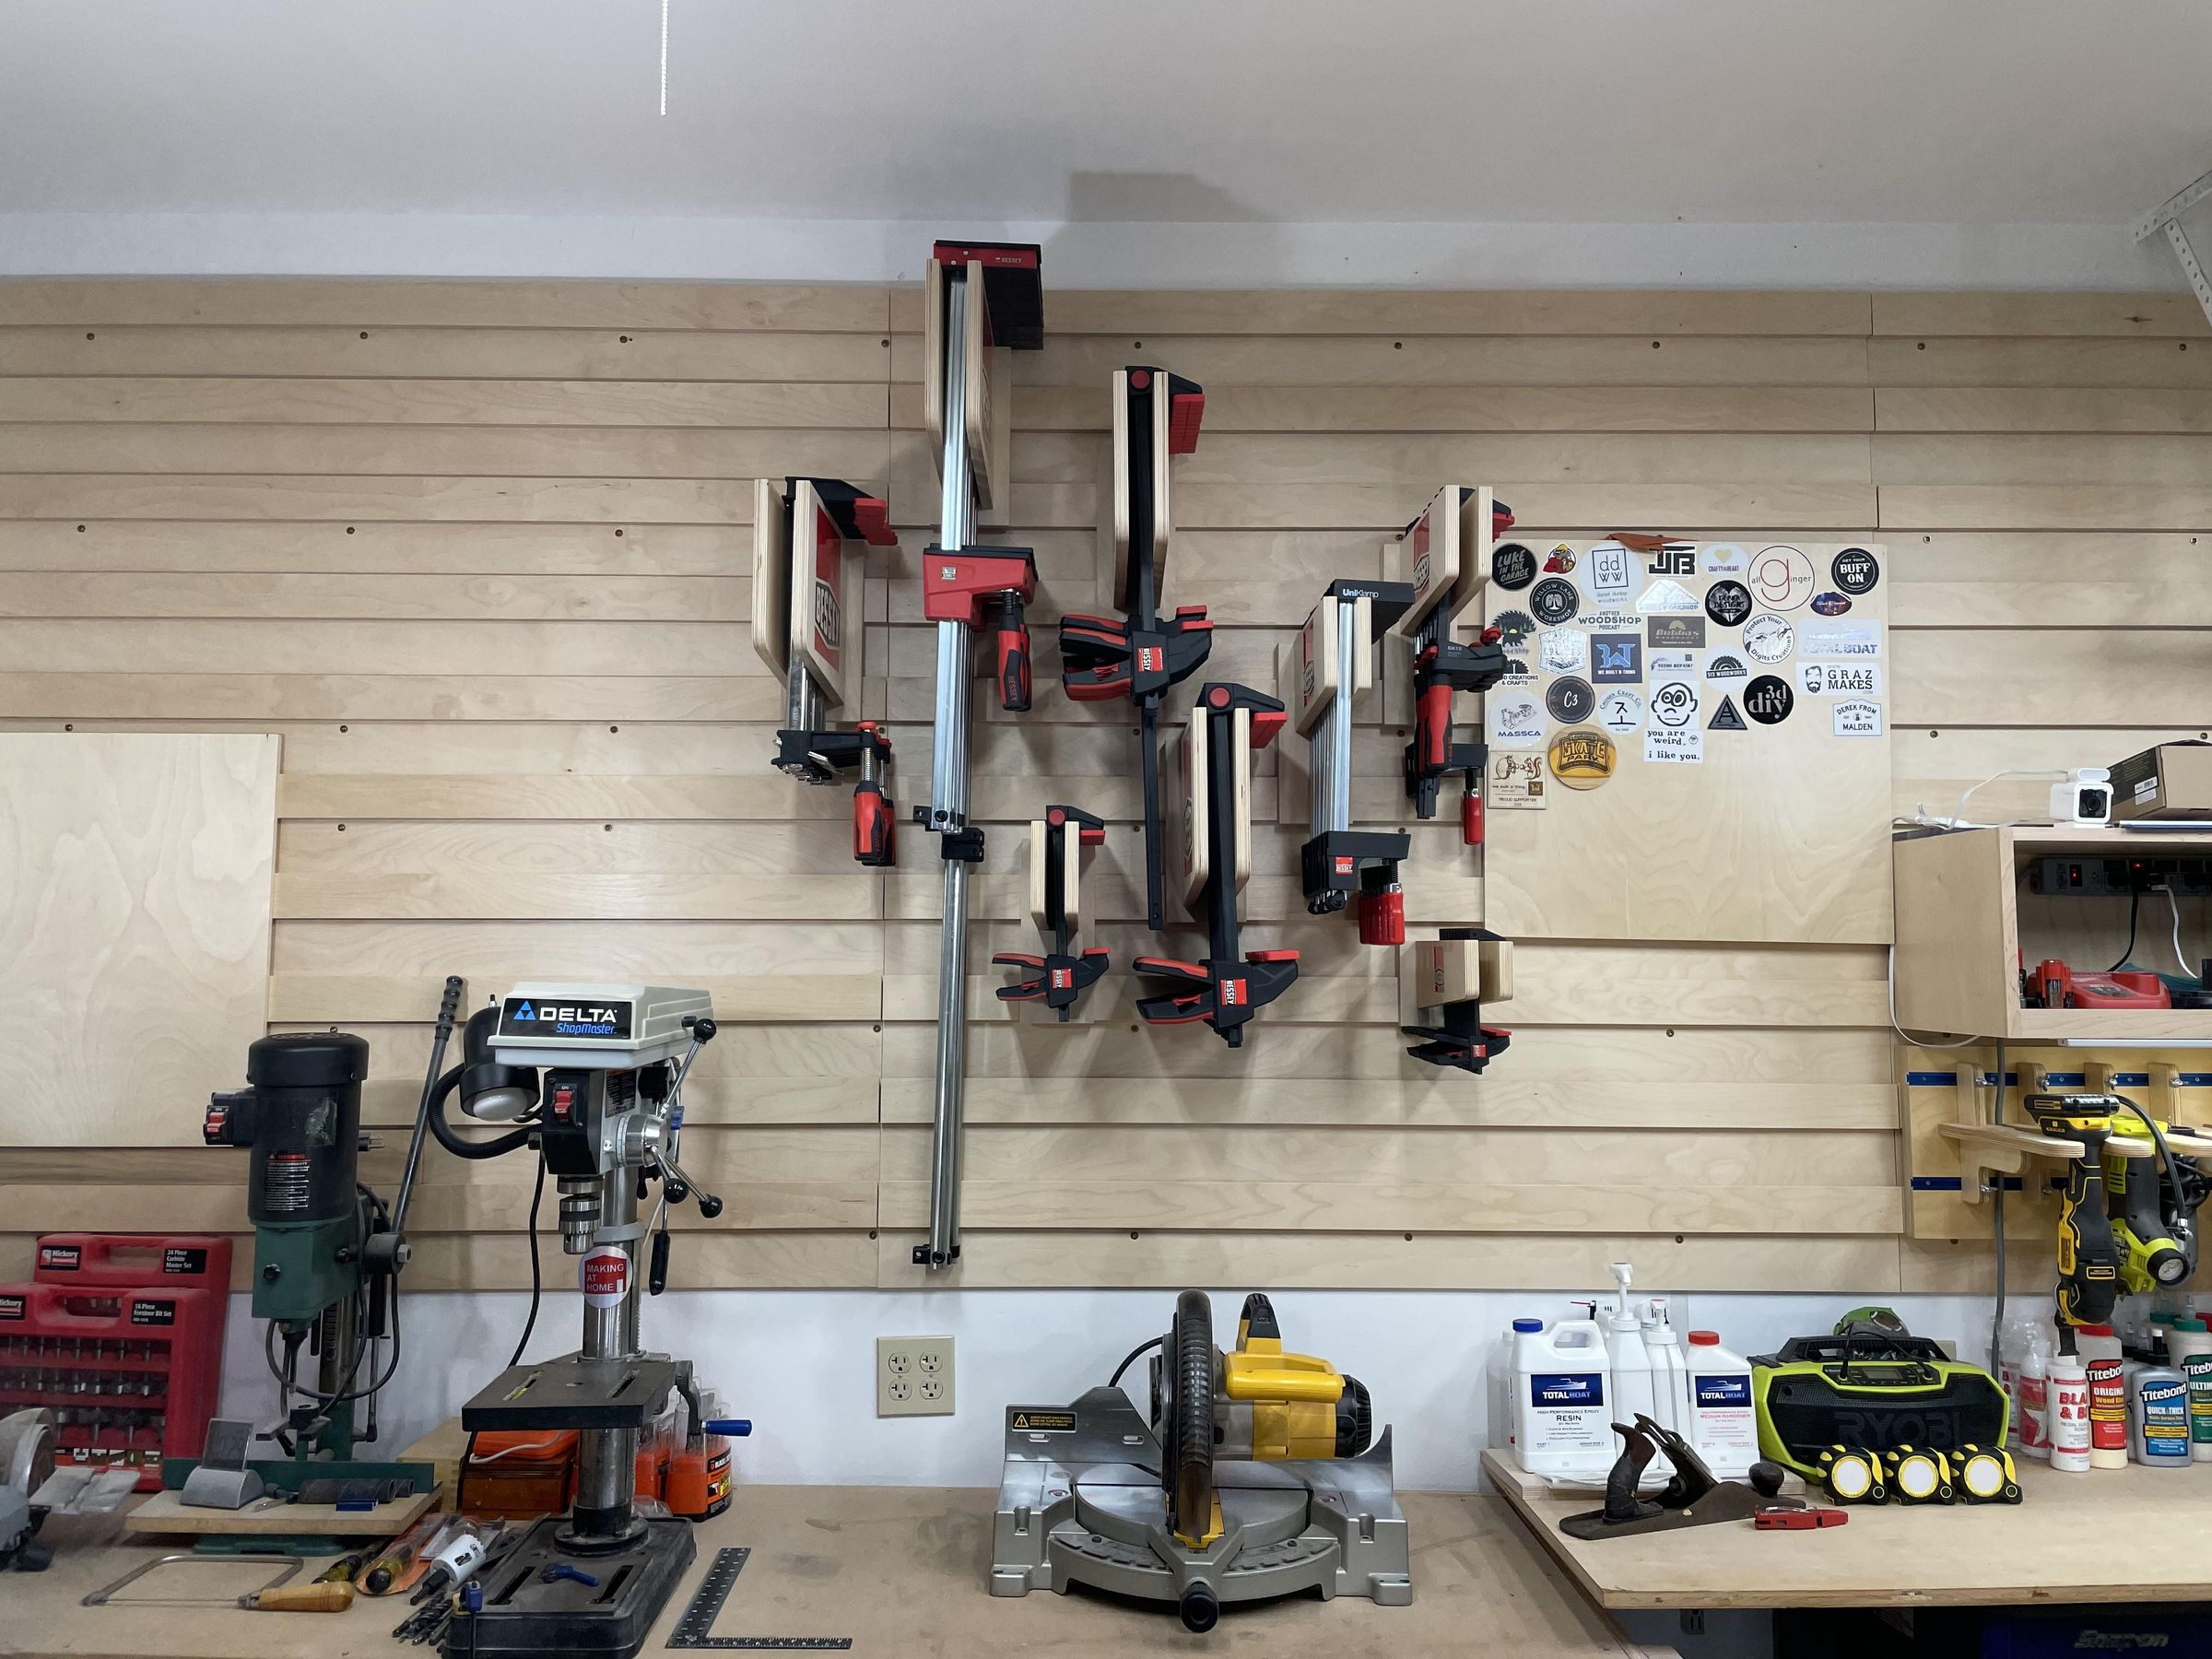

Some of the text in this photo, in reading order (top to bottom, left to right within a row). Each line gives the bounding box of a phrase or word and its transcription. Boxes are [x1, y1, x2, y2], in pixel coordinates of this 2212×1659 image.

[1497, 549, 1526, 568] LUKE
[1500, 562, 1524, 575] IN THE
[1840, 563, 1870, 573] BUFF
[1500, 568, 1529, 582] GARAGE
[1847, 573, 1864, 582] ON
[1535, 583, 1573, 602] WILLOW LANE
[1539, 609, 1572, 621] WORKSHOP
[1746, 616, 1783, 634] Protect Your
[1143, 648, 1151, 671] BESSEY
[1751, 648, 1770, 661] Digits
[1828, 670, 1873, 679] GRAZ
[1828, 680, 1873, 689] MAKES
[1747, 692, 1787, 719] diy
[1836, 704, 1877, 715] DEREK FROM
[1653, 736, 1686, 746] weird.
[1563, 741, 1606, 759] SKATE
[1649, 750, 1652, 759] i
[1657, 750, 1676, 759] like
[539, 1007, 617, 1022] DELTA
[557, 1023, 616, 1035] ShopMaster
[587, 1264, 624, 1273] MAKING
[587, 1274, 596, 1282] AT
[587, 1283, 614, 1292] HOME
[0, 1299, 22, 1308] ickory
[2087, 1364, 2124, 1381] Titebo
[2183, 1361, 2212, 1375] Titeb
[2094, 1387, 2124, 1395] ORIGIN
[2141, 1383, 2186, 1401] Titebond
[2190, 1382, 2212, 1390] ULTIM
[1542, 1391, 1591, 1399] TOTALBOAT
[2147, 1406, 2184, 1415] QUICK THICK
[1834, 1411, 1960, 1449] RYOBI
